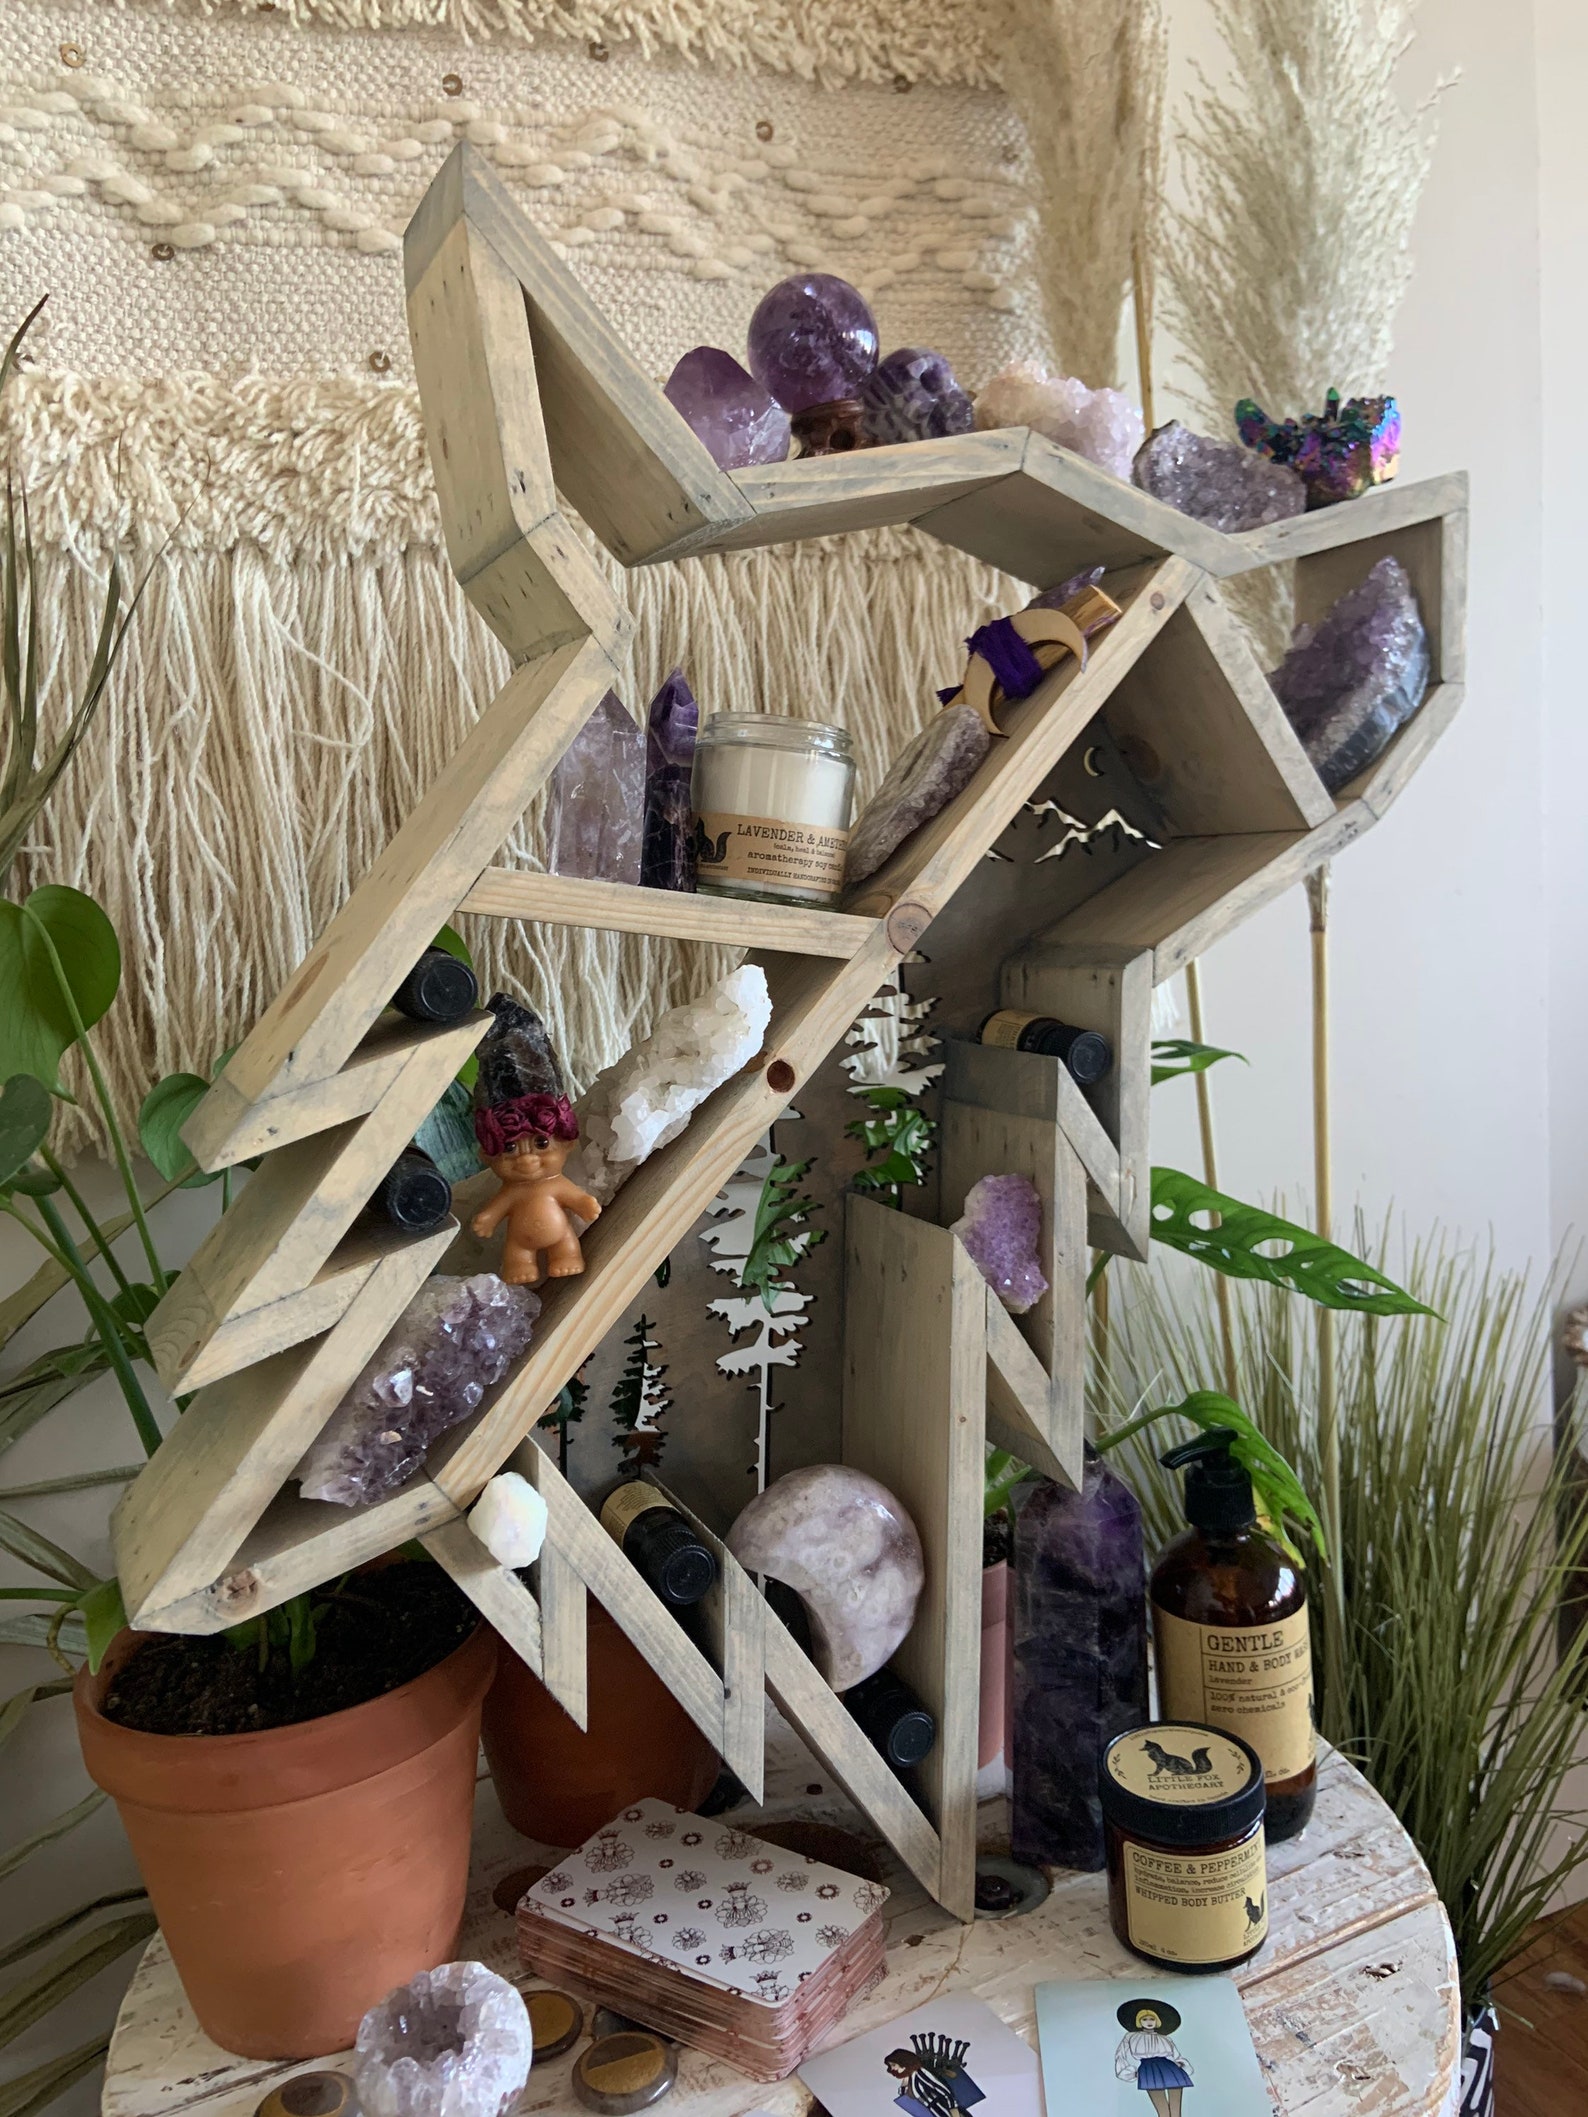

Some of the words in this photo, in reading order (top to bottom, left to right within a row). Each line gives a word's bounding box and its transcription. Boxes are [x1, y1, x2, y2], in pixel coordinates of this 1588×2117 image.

[737, 823, 804, 844] LAVENDER
[807, 833, 816, 845] &
[747, 851, 814, 869] aromatherapy
[815, 860, 828, 871] soy
[747, 866, 792, 879] INDIVIDUALLY
[1207, 1630, 1284, 1653] GENTLE
[1208, 1659, 1245, 1673] HAND
[1249, 1661, 1259, 1673] &
[1263, 1652, 1292, 1671] BODY
[1239, 1690, 1278, 1703] natural
[1236, 1701, 1286, 1714] chemicals
[1147, 1774, 1193, 1784] LITTLE
[1195, 1773, 1221, 1782] FOX
[1148, 1781, 1225, 1791] APOTHECARY
[1132, 1851, 1183, 1874] COFFEE
[1186, 1863, 1197, 1875] &
[1135, 1884, 1179, 1906] WHIPPED
[1181, 1897, 1209, 1908] BODY
[1211, 1886, 1247, 1906] BUTTER
